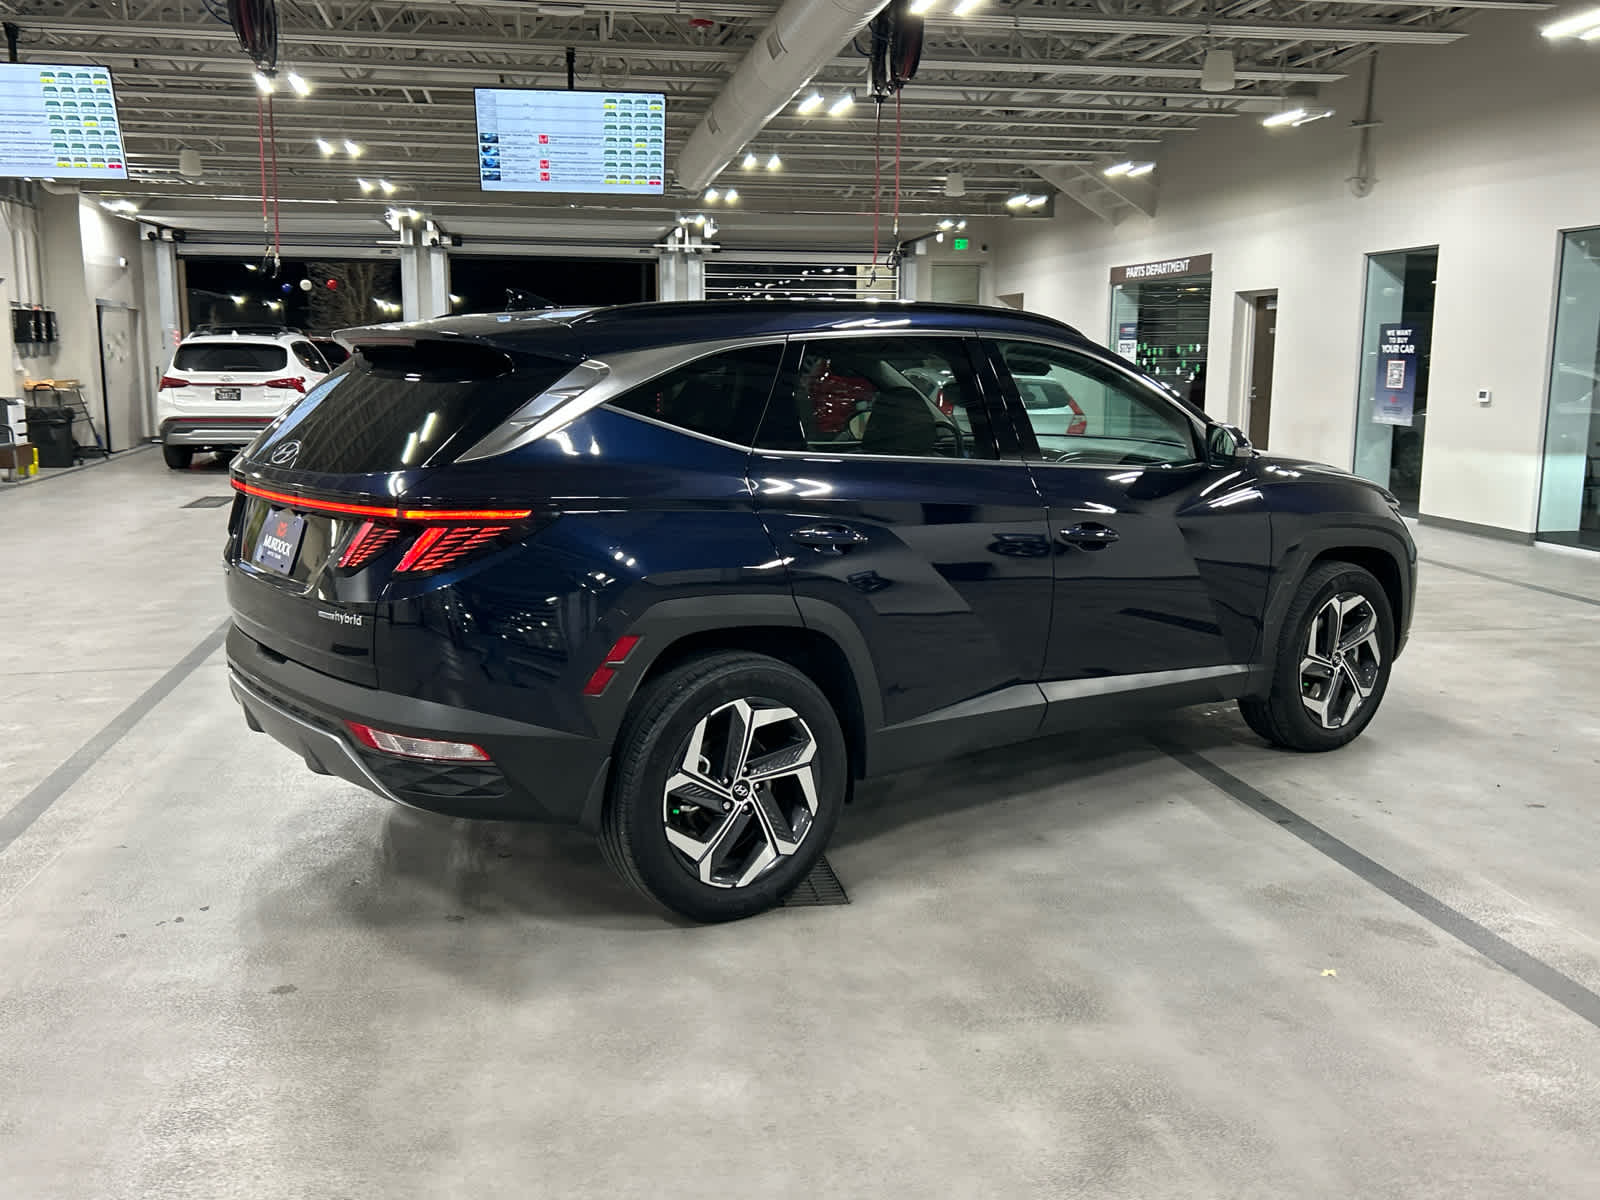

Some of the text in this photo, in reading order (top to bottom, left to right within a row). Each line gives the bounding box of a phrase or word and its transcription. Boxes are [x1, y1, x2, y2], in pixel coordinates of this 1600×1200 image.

[1126, 259, 1190, 278] PARTS DEPARTMENT
[1382, 344, 1415, 353] YOUR CAR
[334, 611, 362, 626] hybrid
